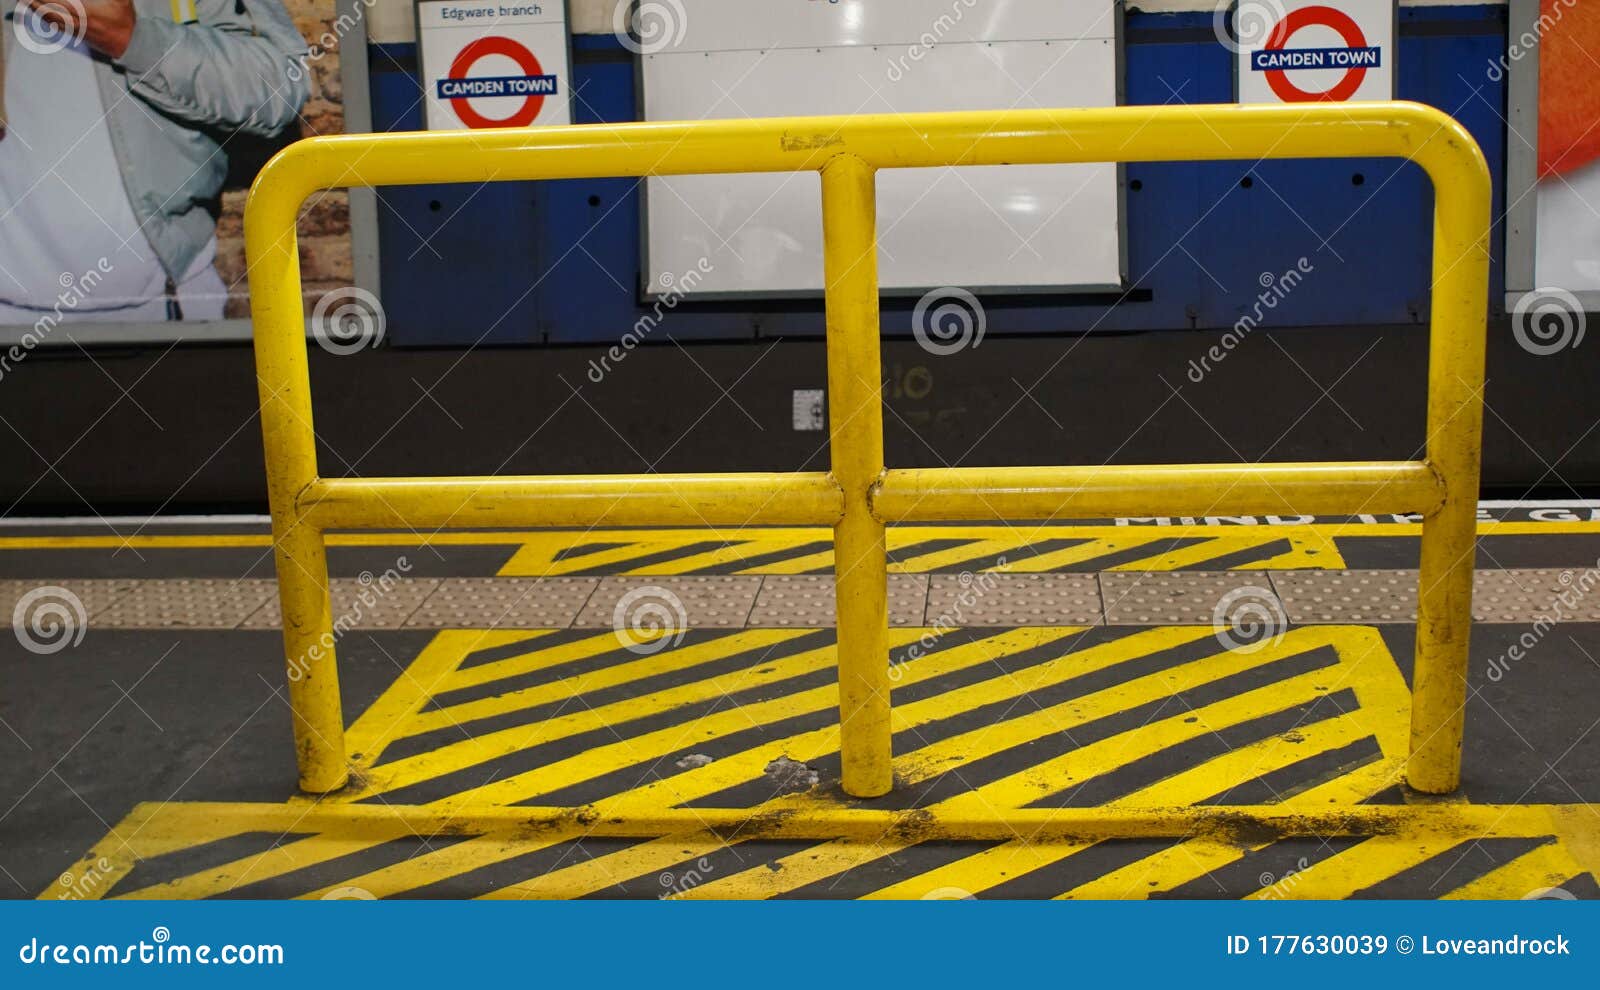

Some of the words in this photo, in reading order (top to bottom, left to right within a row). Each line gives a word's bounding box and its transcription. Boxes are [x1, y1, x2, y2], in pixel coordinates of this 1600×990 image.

[441, 7, 495, 21] Edgware
[499, 5, 542, 17] branch
[1256, 52, 1324, 67] CAMDEN
[1328, 51, 1377, 65] TOWN
[441, 80, 505, 96] CAMDEN
[507, 78, 554, 93] TOWN
[1114, 515, 1315, 527] MIND
